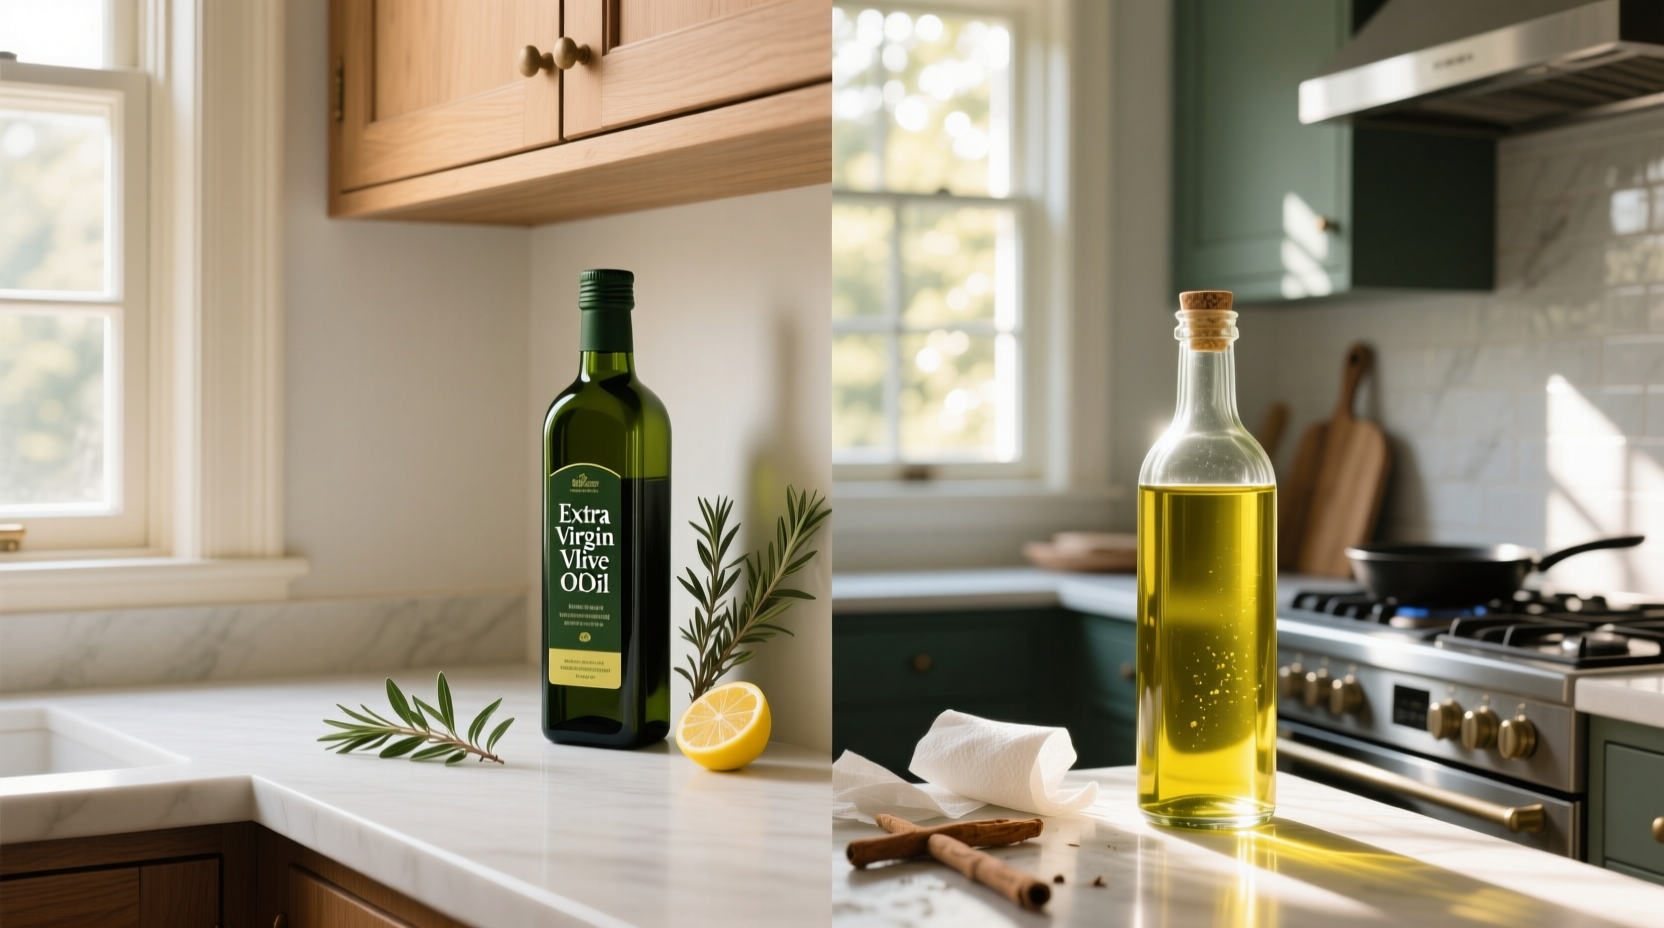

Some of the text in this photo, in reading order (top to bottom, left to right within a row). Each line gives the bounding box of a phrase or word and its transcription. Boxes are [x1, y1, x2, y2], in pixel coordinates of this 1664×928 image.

[559, 503, 611, 524] Extra
[554, 526, 615, 551] Virgin
[559, 549, 610, 570] Vlive
